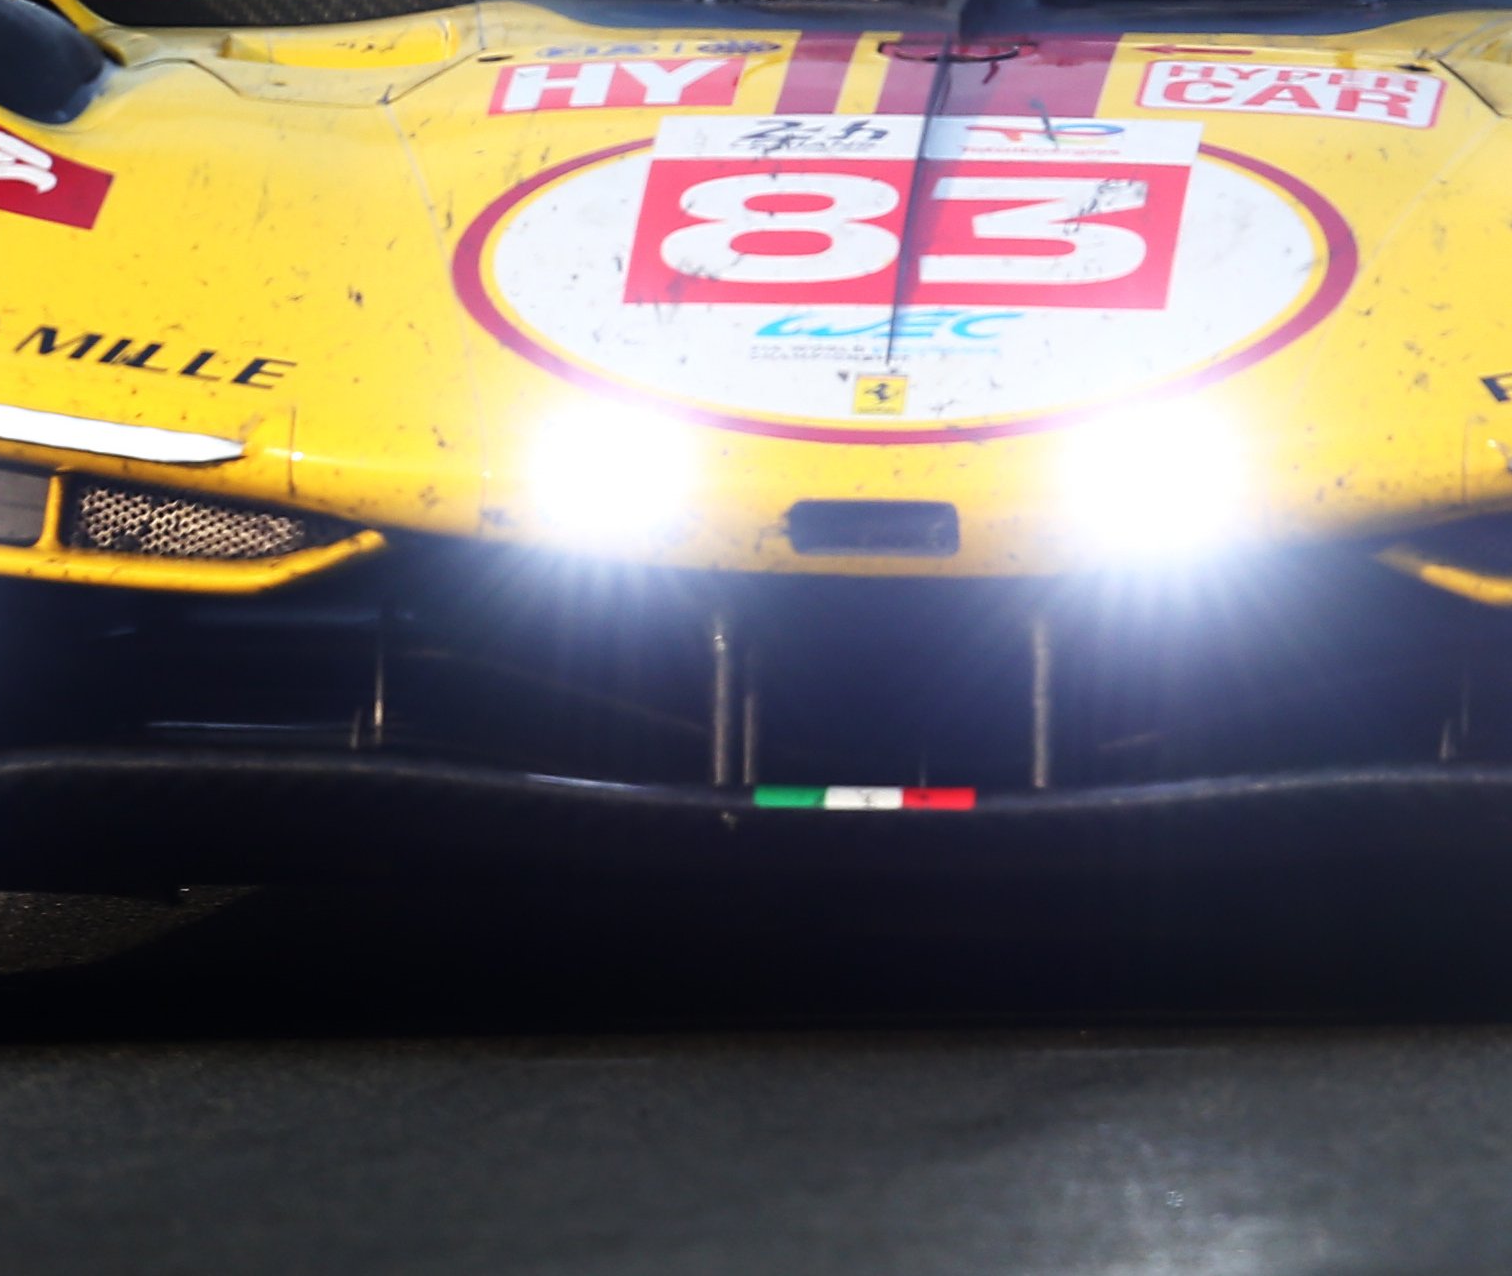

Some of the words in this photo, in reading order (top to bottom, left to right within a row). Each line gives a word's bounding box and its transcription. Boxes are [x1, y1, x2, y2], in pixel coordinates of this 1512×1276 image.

[502, 58, 729, 112] HY
[1162, 79, 1412, 120] CAR
[1167, 64, 1420, 92] HYPER
[660, 172, 1148, 285] 83
[754, 309, 1024, 339] WEC
[14, 325, 298, 391] MILLE
